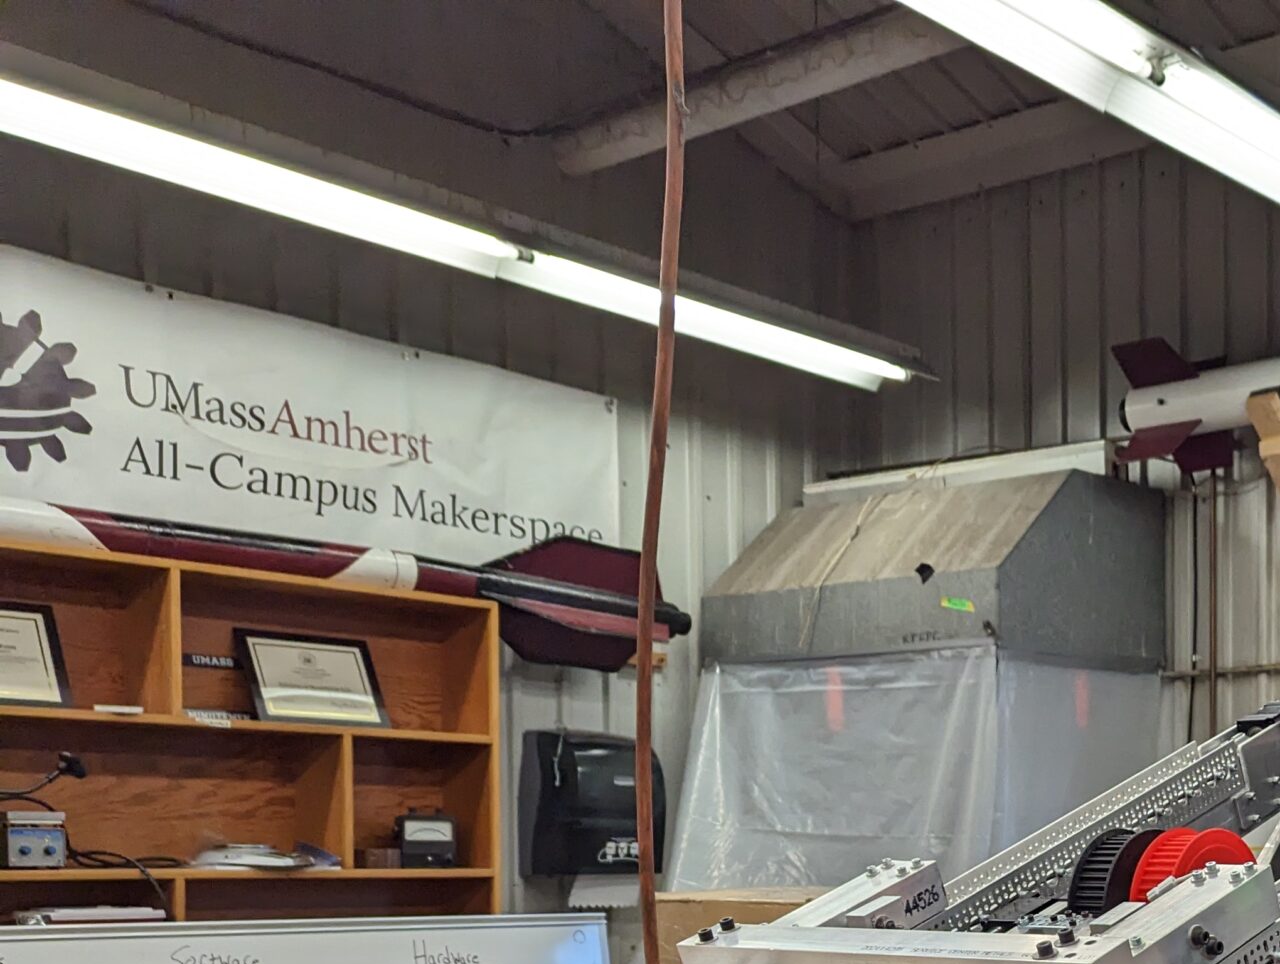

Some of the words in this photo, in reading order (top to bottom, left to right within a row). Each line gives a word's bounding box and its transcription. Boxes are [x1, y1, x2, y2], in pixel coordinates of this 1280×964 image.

[118, 364, 433, 464] UMassAmherst
[120, 436, 378, 516] All-Campus
[904, 884, 940, 917] 44526
